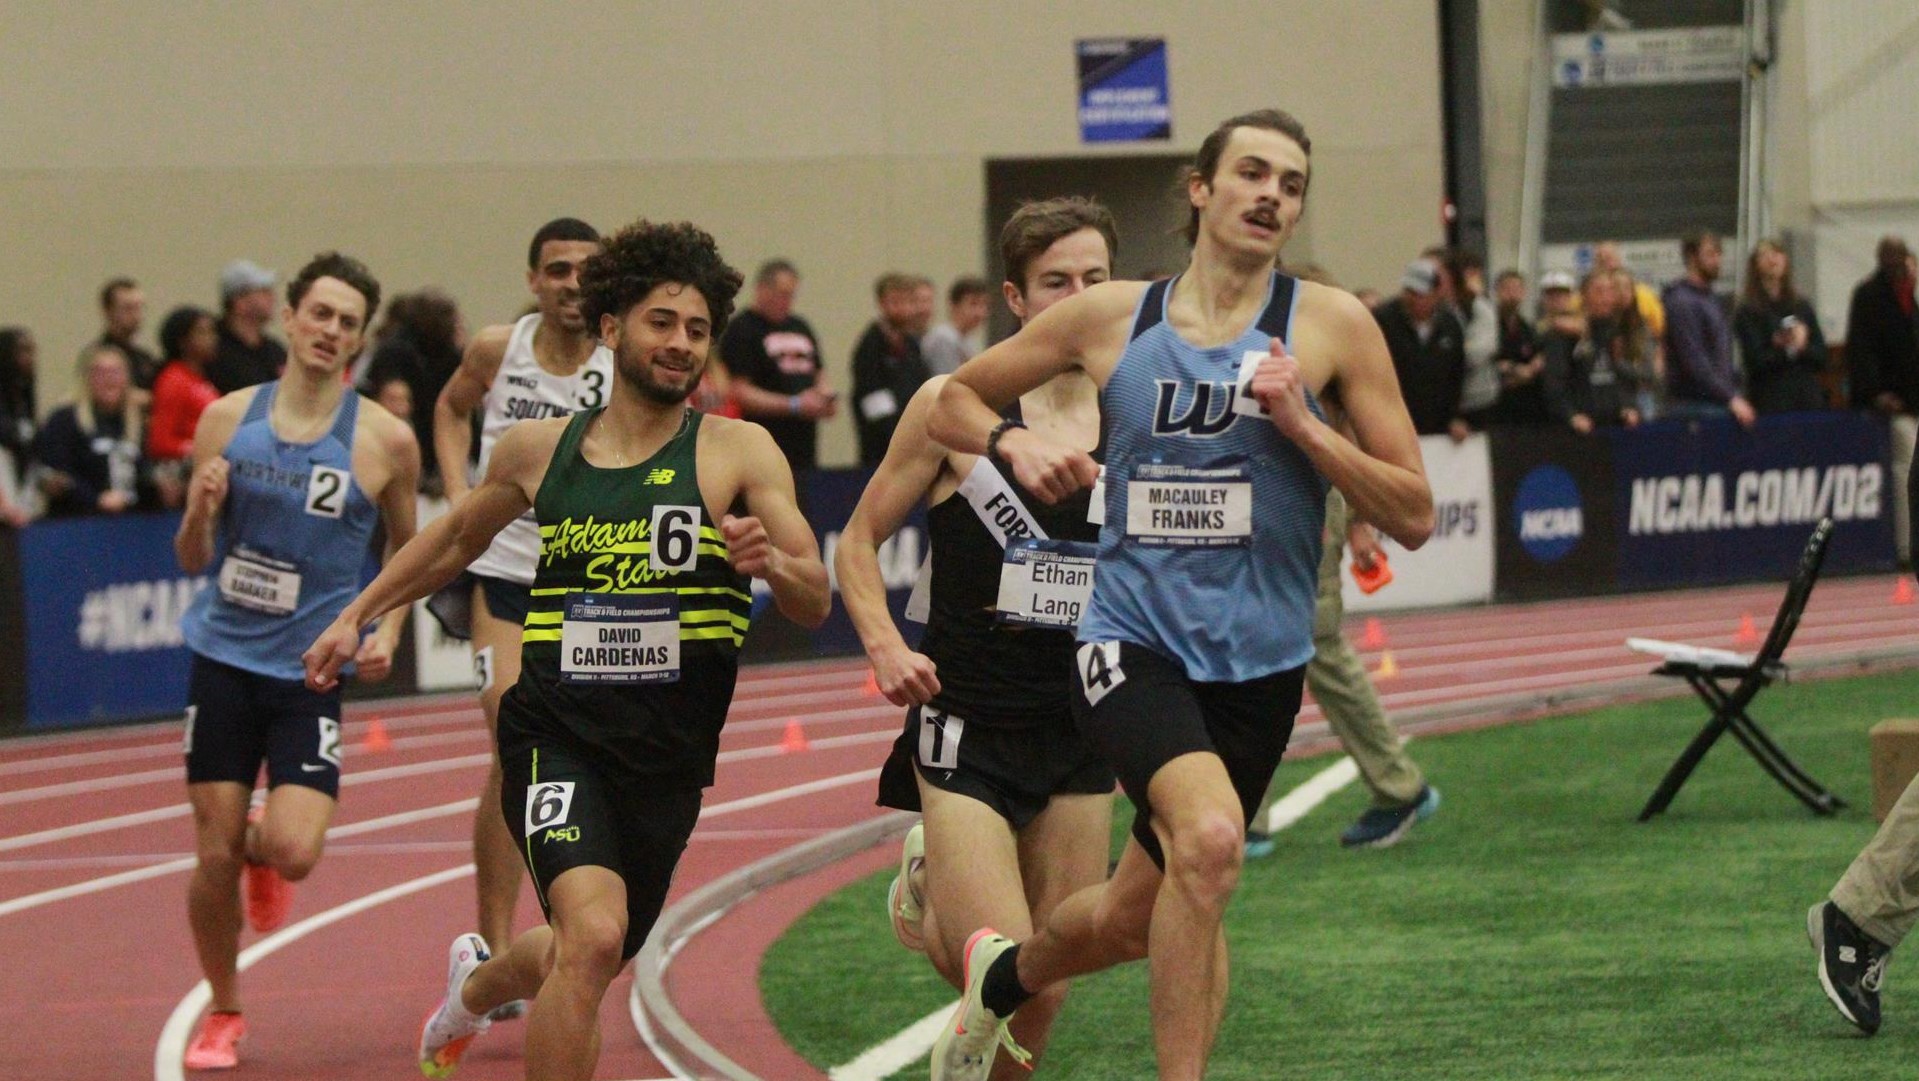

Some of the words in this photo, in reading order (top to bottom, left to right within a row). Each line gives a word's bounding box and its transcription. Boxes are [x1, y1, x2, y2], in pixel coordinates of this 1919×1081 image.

[580, 370, 604, 408] 3
[312, 472, 340, 513] 2
[1149, 488, 1227, 505] MACAULEY
[1628, 465, 1883, 535] NCAA.COM/D2
[657, 510, 693, 567] 6
[1152, 509, 1224, 530] FRANKS
[1520, 508, 1583, 540] NCAA
[546, 515, 652, 567] Adam
[1032, 562, 1088, 586] Ethan
[1032, 593, 1080, 622] Lang
[598, 628, 641, 643] DAVID
[572, 646, 668, 667] CARDENAS
[1087, 645, 1112, 689] 4
[926, 714, 948, 763] 1
[531, 785, 565, 826] 6
